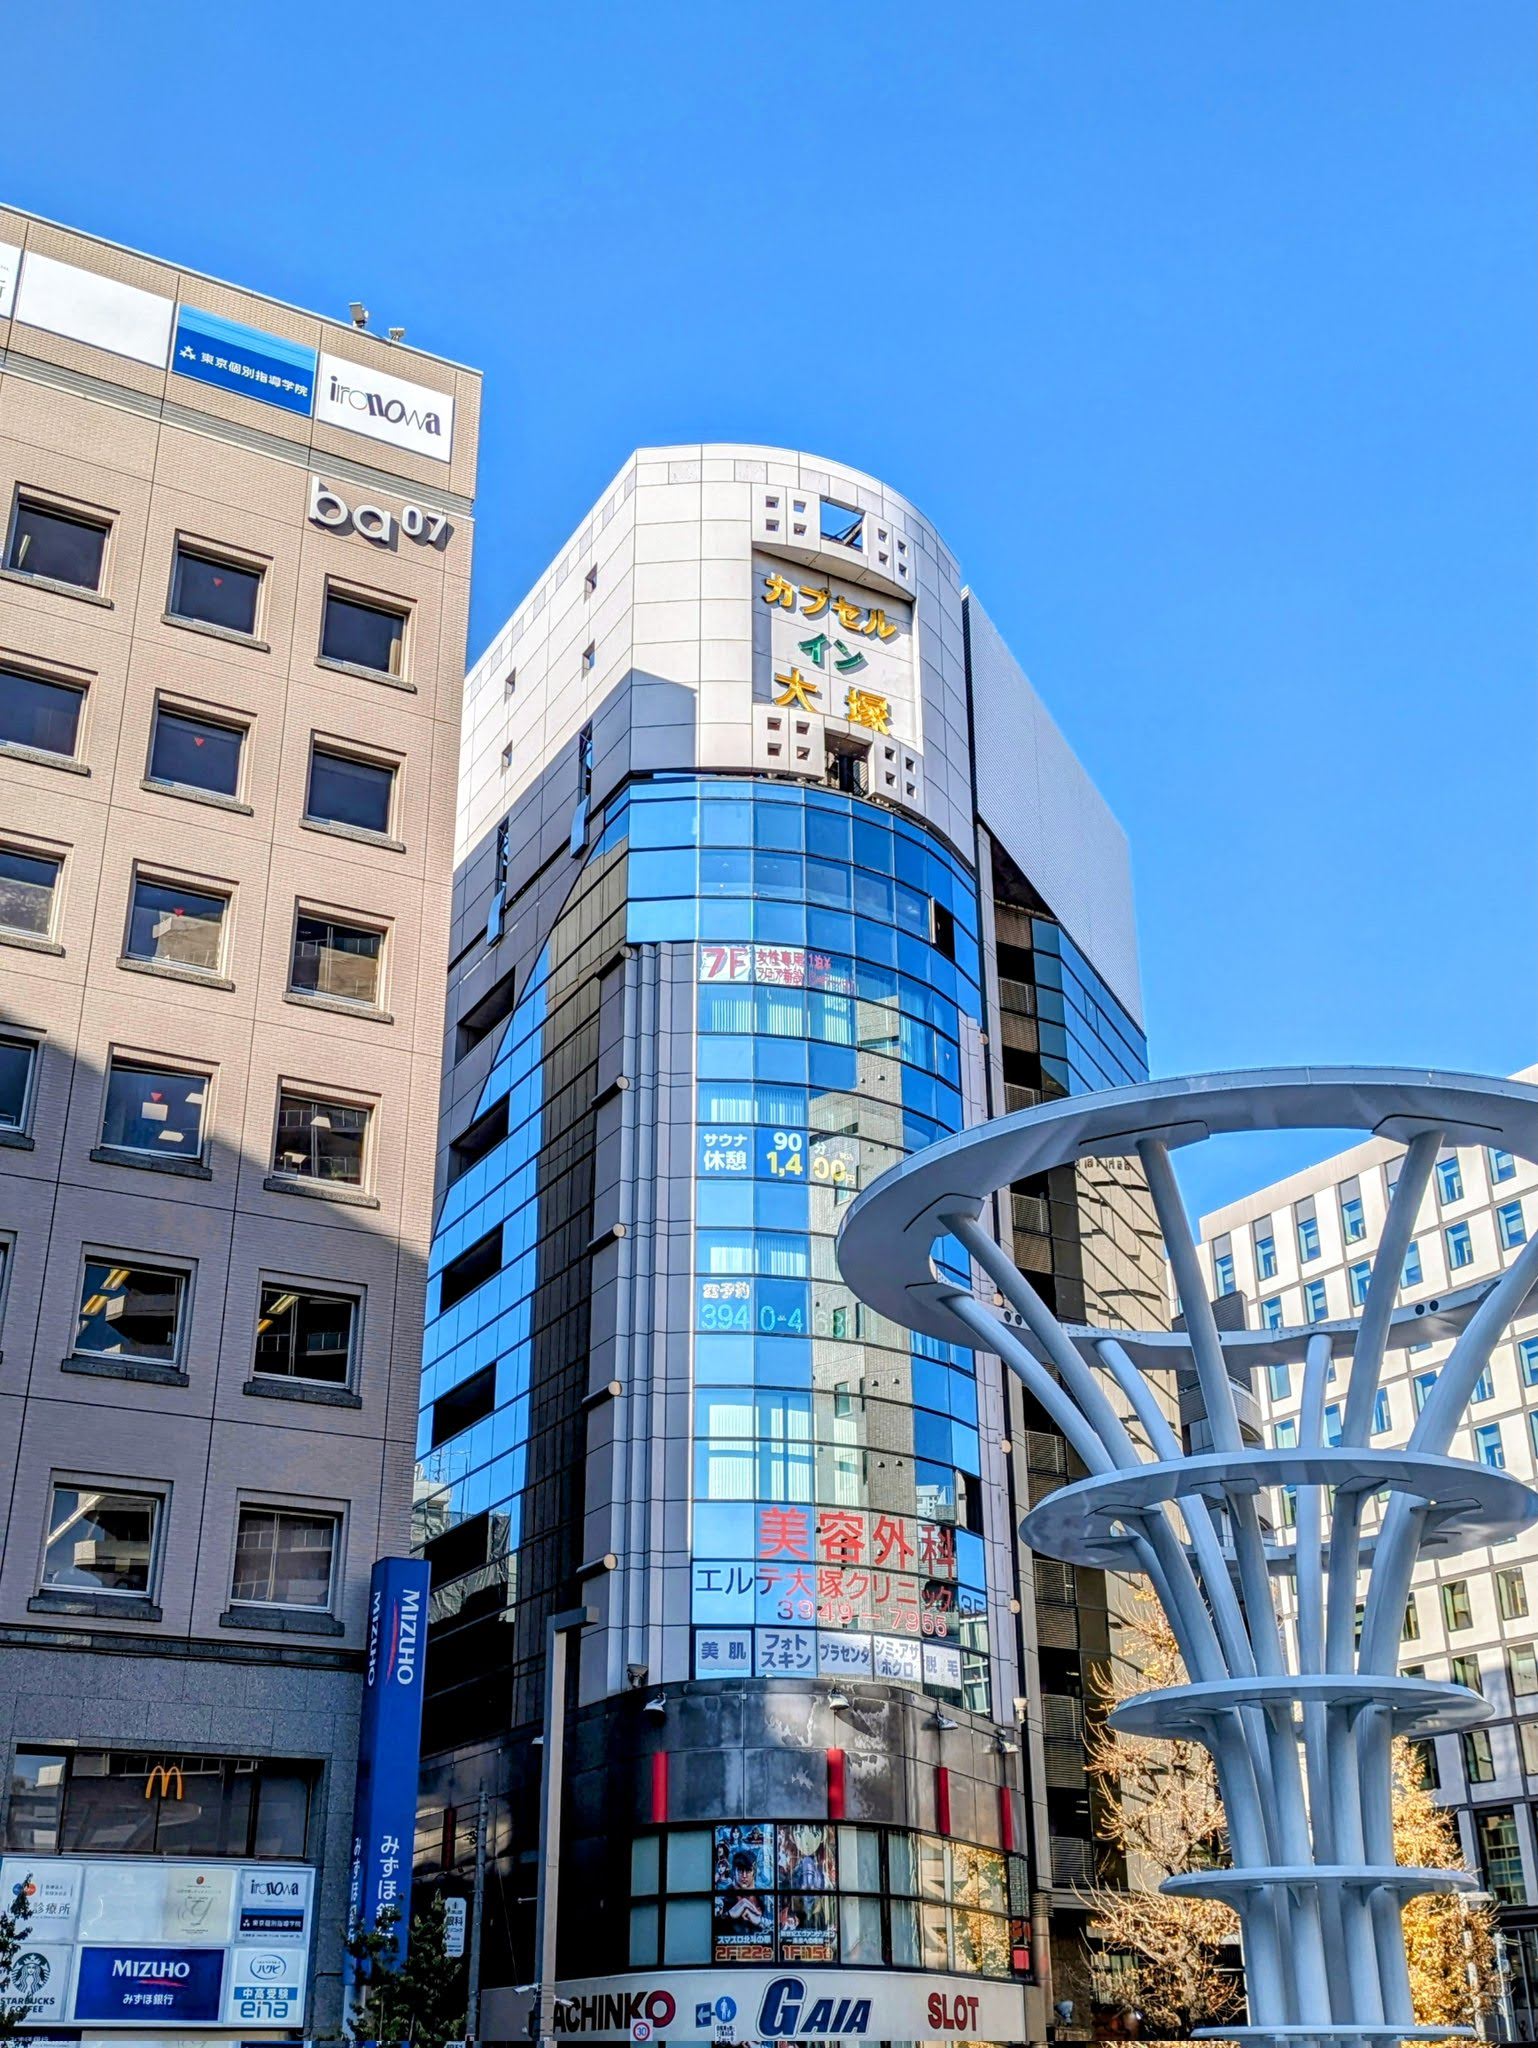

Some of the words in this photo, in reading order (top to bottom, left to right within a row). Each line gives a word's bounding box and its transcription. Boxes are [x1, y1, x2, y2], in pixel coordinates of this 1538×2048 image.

[200, 351, 309, 398] 東京個別指導学院
[763, 573, 898, 639] カプセル
[798, 632, 864, 670] イン
[773, 666, 892, 736] 大塚
[702, 946, 748, 980] 7F
[756, 949, 804, 967] 女性専用
[703, 1133, 748, 1147] サウナ
[703, 1150, 747, 1171] 休憩
[759, 1506, 954, 1580] 美容外科
[695, 1566, 954, 1613] エルテ大塚クリニック
[368, 1591, 381, 1687] MIZUHO
[397, 1589, 420, 1685] MIZUHO
[765, 1633, 808, 1652] フォト
[701, 1641, 747, 1660] 美肌
[761, 1651, 812, 1670] スキン
[881, 1659, 914, 1678] ホクロ
[926, 1655, 959, 1678] 脱毛
[112, 1960, 190, 1978] MIZUHO
[122, 1993, 174, 2006] みずほ銀行
[243, 1988, 289, 2000] 中高受験
[9, 2005, 44, 2013] COFEE
[240, 2001, 289, 2018] ena
[757, 1975, 873, 2036] GAIA
[927, 1992, 979, 2032] SLOT
[637, 2027, 646, 2036] 30
